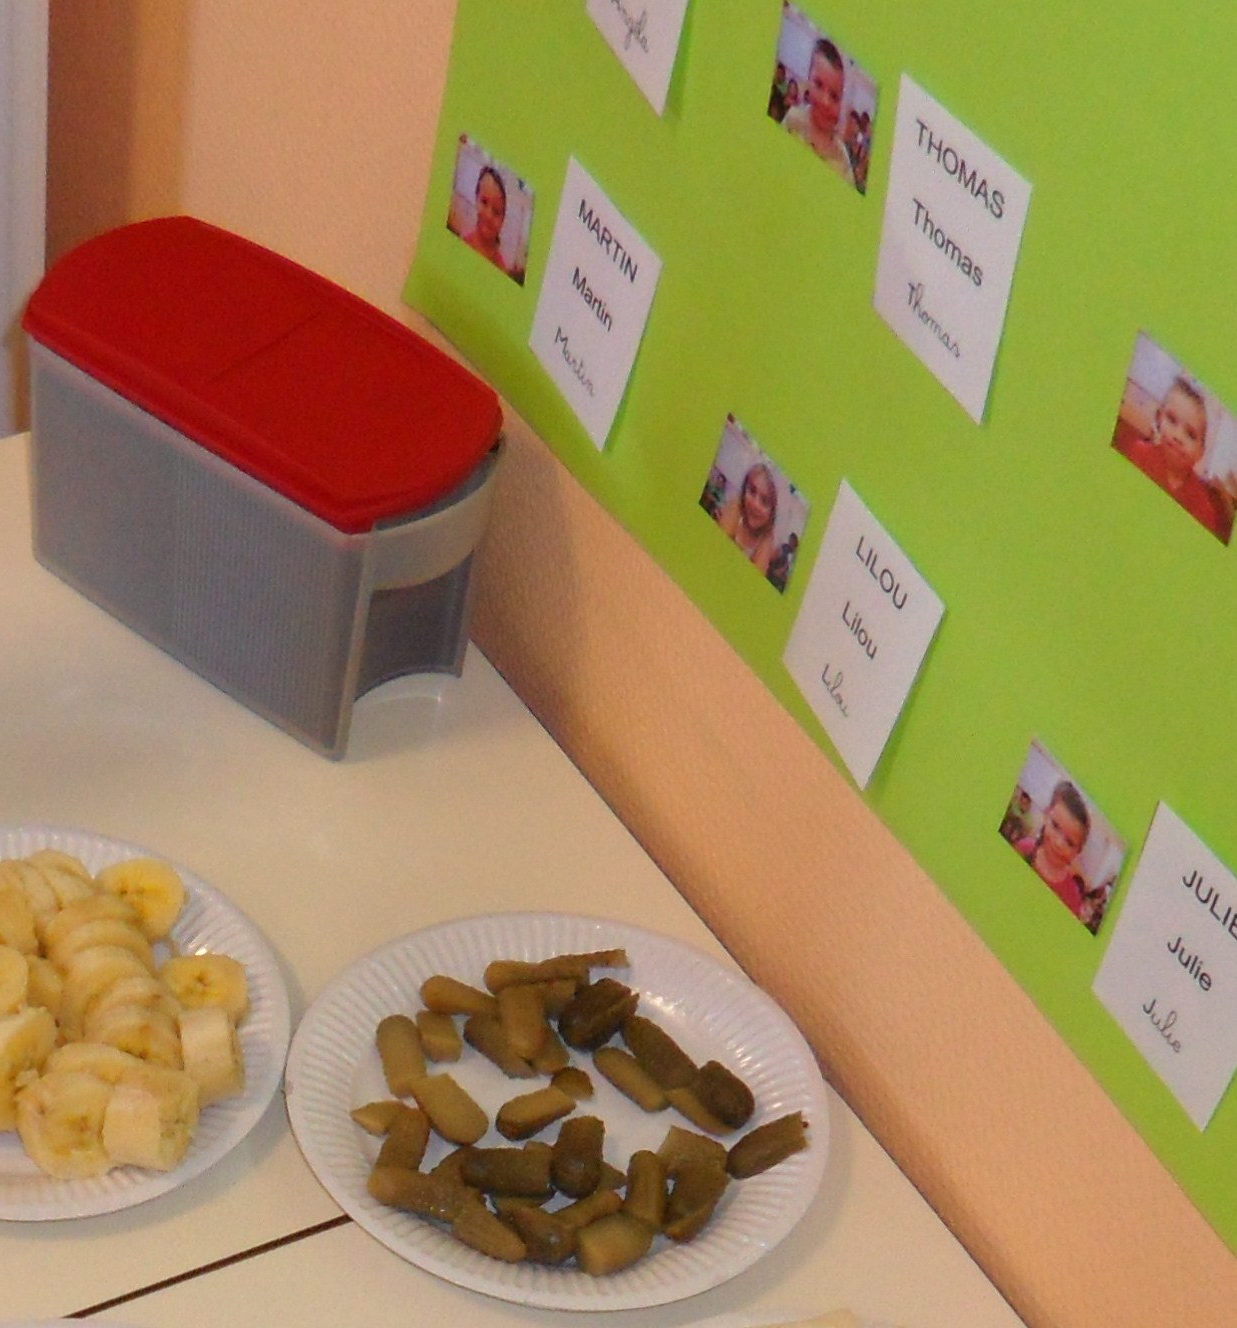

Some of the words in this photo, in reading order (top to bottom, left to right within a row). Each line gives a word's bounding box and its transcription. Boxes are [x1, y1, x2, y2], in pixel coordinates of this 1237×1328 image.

[916, 118, 1005, 219] THOMAS
[578, 199, 638, 284] MARTIN
[913, 198, 984, 287] Thomas
[572, 267, 613, 332] Martin
[907, 282, 960, 358] Thomas
[555, 326, 595, 397] Martin
[856, 536, 908, 610] LILOU
[842, 601, 878, 660] Lilou
[1182, 870, 1237, 941] JULIE
[1167, 937, 1212, 992] Julie
[1142, 999, 1181, 1054] Julie
